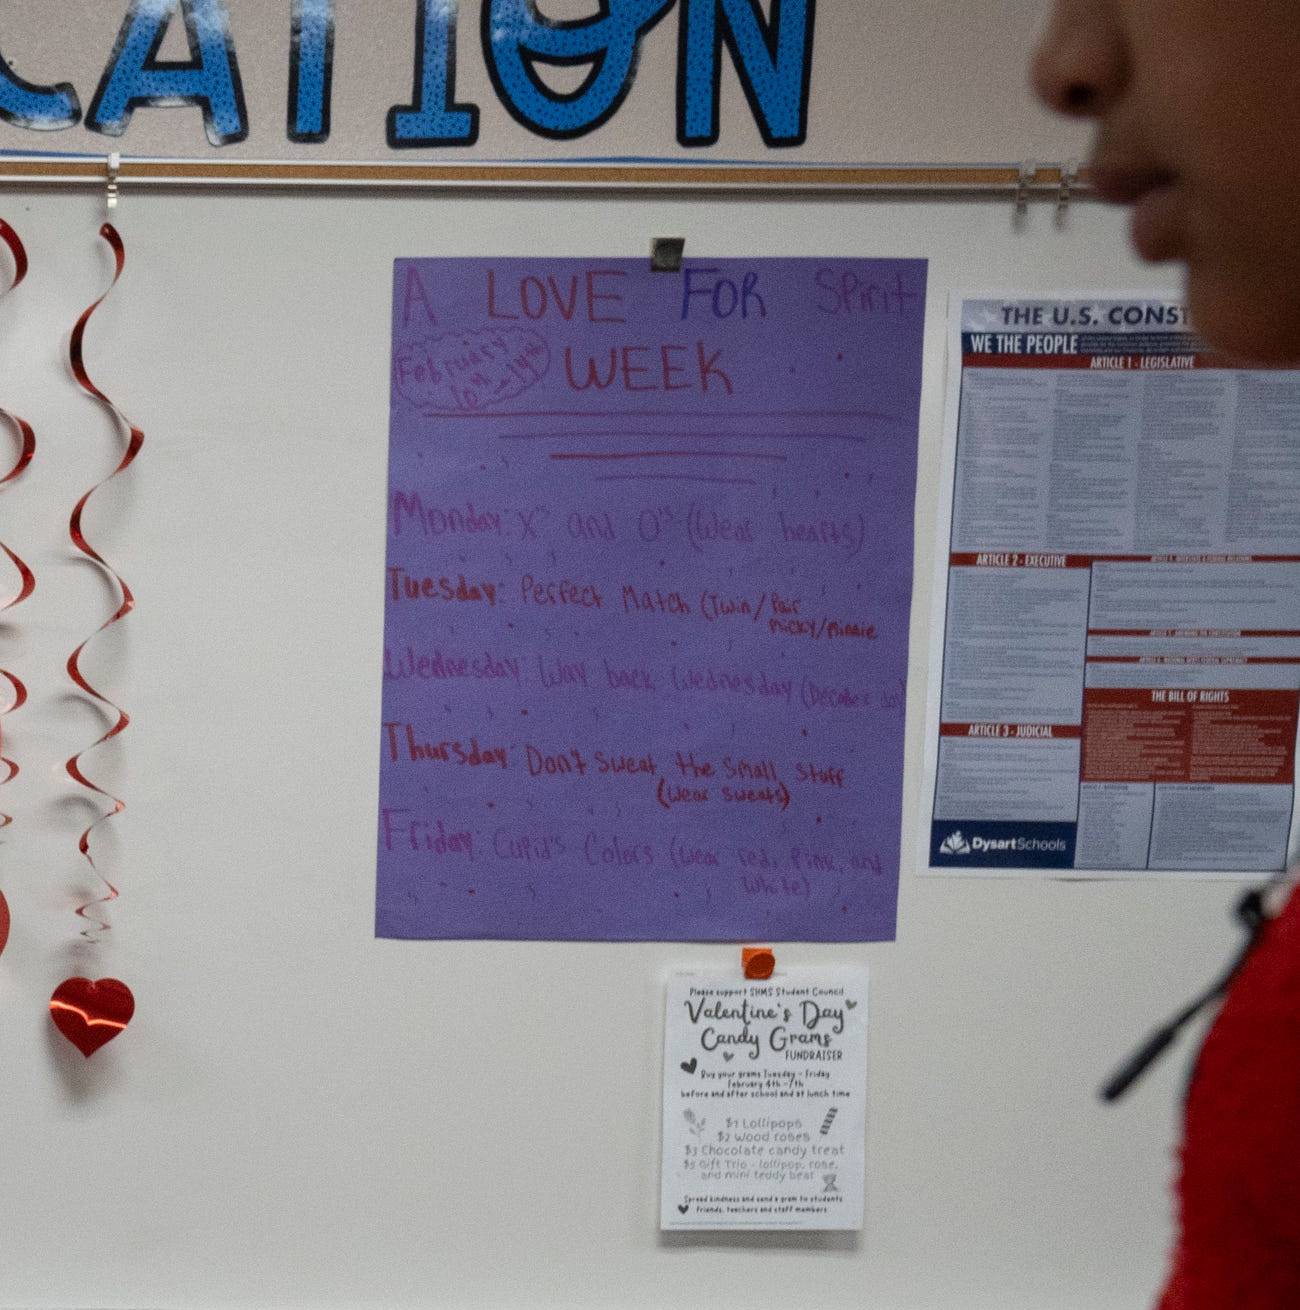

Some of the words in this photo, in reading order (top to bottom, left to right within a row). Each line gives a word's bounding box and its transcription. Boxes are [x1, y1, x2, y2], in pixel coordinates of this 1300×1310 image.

[402, 264, 437, 327] A
[486, 268, 628, 324] LOVE
[680, 267, 767, 320] FOR
[1001, 306, 1044, 325] THE
[1053, 306, 1098, 326] U.S.
[970, 334, 993, 354] WE
[996, 334, 1023, 354] THE
[1026, 334, 1079, 355] PEOPLE
[565, 339, 734, 394] WEEK
[1090, 356, 1124, 370] ARTICLE
[1140, 356, 1195, 370] LEGISLATIVE
[976, 554, 1009, 566] ARTICLE
[1025, 555, 1066, 567] EXECUTIVE
[622, 585, 690, 616] Match
[1151, 690, 1167, 702] THE
[1169, 690, 1185, 703] BILL
[1187, 691, 1198, 703] OF
[1200, 691, 1230, 704] RIGHTS
[968, 725, 1001, 737] ARTICLE
[1015, 725, 1052, 738] JUDICIAL
[690, 987, 713, 997] Please
[716, 987, 746, 998] support
[750, 987, 772, 997] SHMS
[776, 987, 809, 997] Student
[812, 987, 844, 997] Council
[684, 997, 791, 1026] Valentine's
[800, 1000, 844, 1034] Day
[701, 1025, 760, 1060] Candy
[770, 1026, 832, 1051] Grams
[785, 1050, 842, 1061] FUNDRAISER
[681, 1090, 708, 1098] before
[711, 1090, 724, 1098] and
[727, 1090, 748, 1098] after
[751, 1090, 777, 1098] school
[780, 1090, 793, 1098] and
[832, 1090, 850, 1098] time
[742, 1118, 802, 1130] Lollipops
[701, 1145, 764, 1156] Chocolate
[769, 1145, 806, 1159] candy
[812, 1145, 845, 1156] treat
